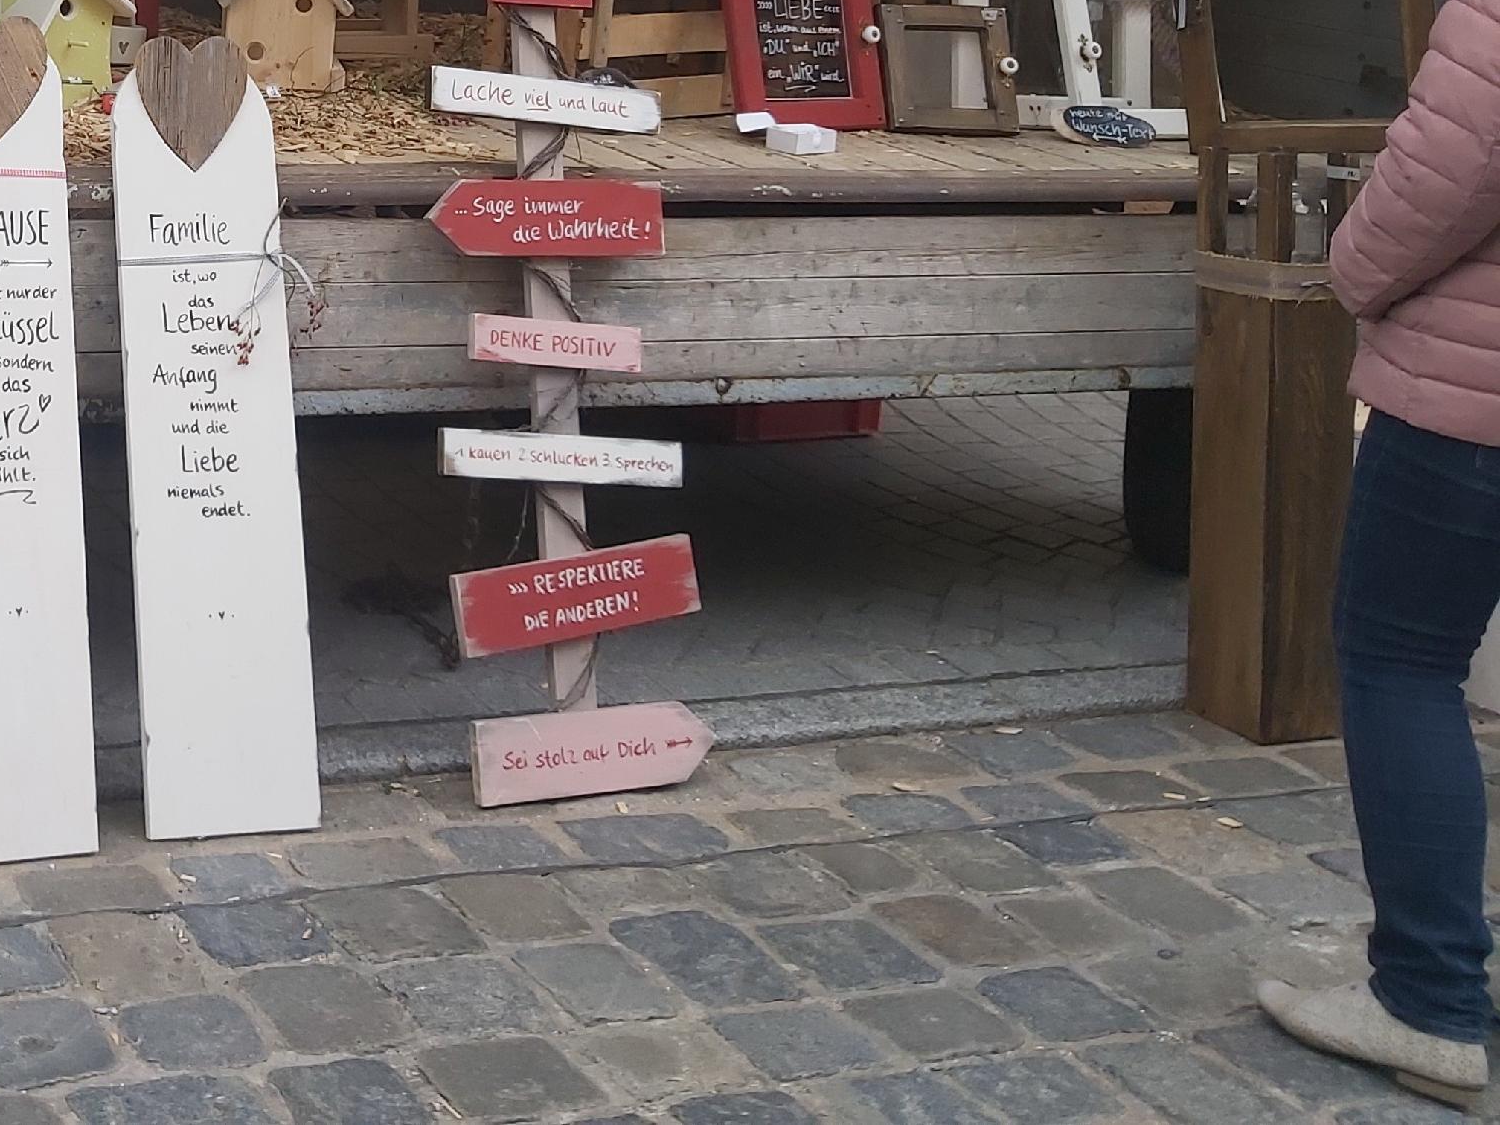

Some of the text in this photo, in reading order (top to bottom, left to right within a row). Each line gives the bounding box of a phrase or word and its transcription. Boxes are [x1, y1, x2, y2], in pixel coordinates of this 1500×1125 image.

[451, 78, 515, 106] Lache
[524, 88, 553, 110] viel
[559, 96, 586, 111] und
[523, 197, 584, 215] immer
[149, 213, 231, 247] Familie
[512, 218, 651, 244] die Wahrheit!
[197, 271, 217, 283] wo
[188, 294, 215, 309] das
[162, 302, 236, 334] Leben
[190, 341, 238, 356] seinen
[489, 328, 617, 359] DENKE POSITIV
[2, 376, 32, 393] das
[153, 363, 218, 394] Anfang
[189, 399, 240, 413] nimmt
[171, 420, 230, 434] und die
[181, 444, 240, 474] Liebe
[166, 485, 226, 500] niemals
[201, 502, 251, 518] endet.
[533, 557, 646, 595] RESPEKTIERE
[523, 591, 640, 633] DIE ANDEREN!
[503, 749, 528, 771] Sei
[535, 746, 578, 770] stolz
[617, 736, 657, 758] Dich
